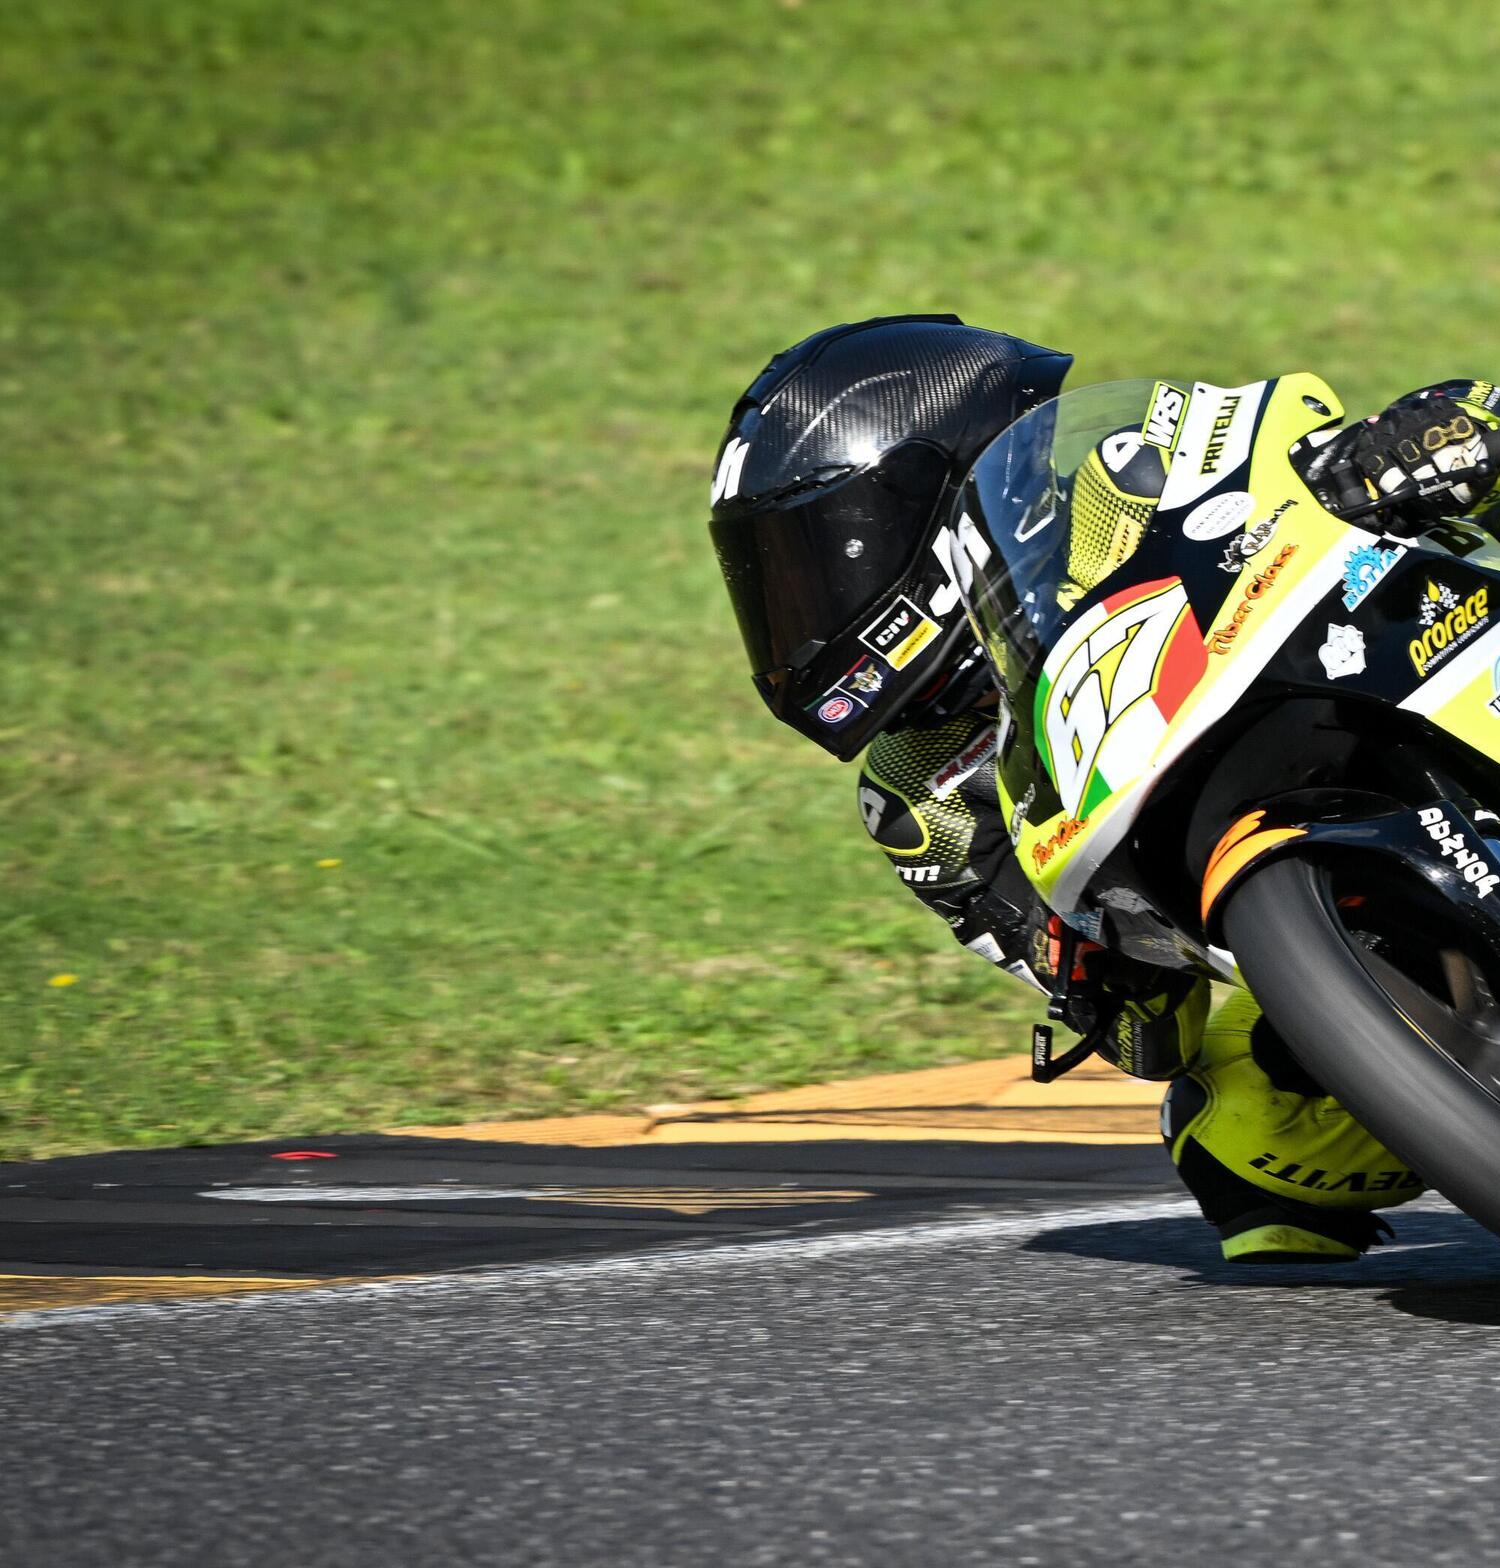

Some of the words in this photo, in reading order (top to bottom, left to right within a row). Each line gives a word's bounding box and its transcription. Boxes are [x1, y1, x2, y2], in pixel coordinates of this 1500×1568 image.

[1200, 396, 1241, 475] PRITELLI
[1345, 549, 1398, 610] BOTTA
[875, 610, 911, 647] CIV
[1409, 588, 1489, 678] prorace
[1044, 583, 1189, 820] 67
[1417, 807, 1500, 899] DUNLOP
